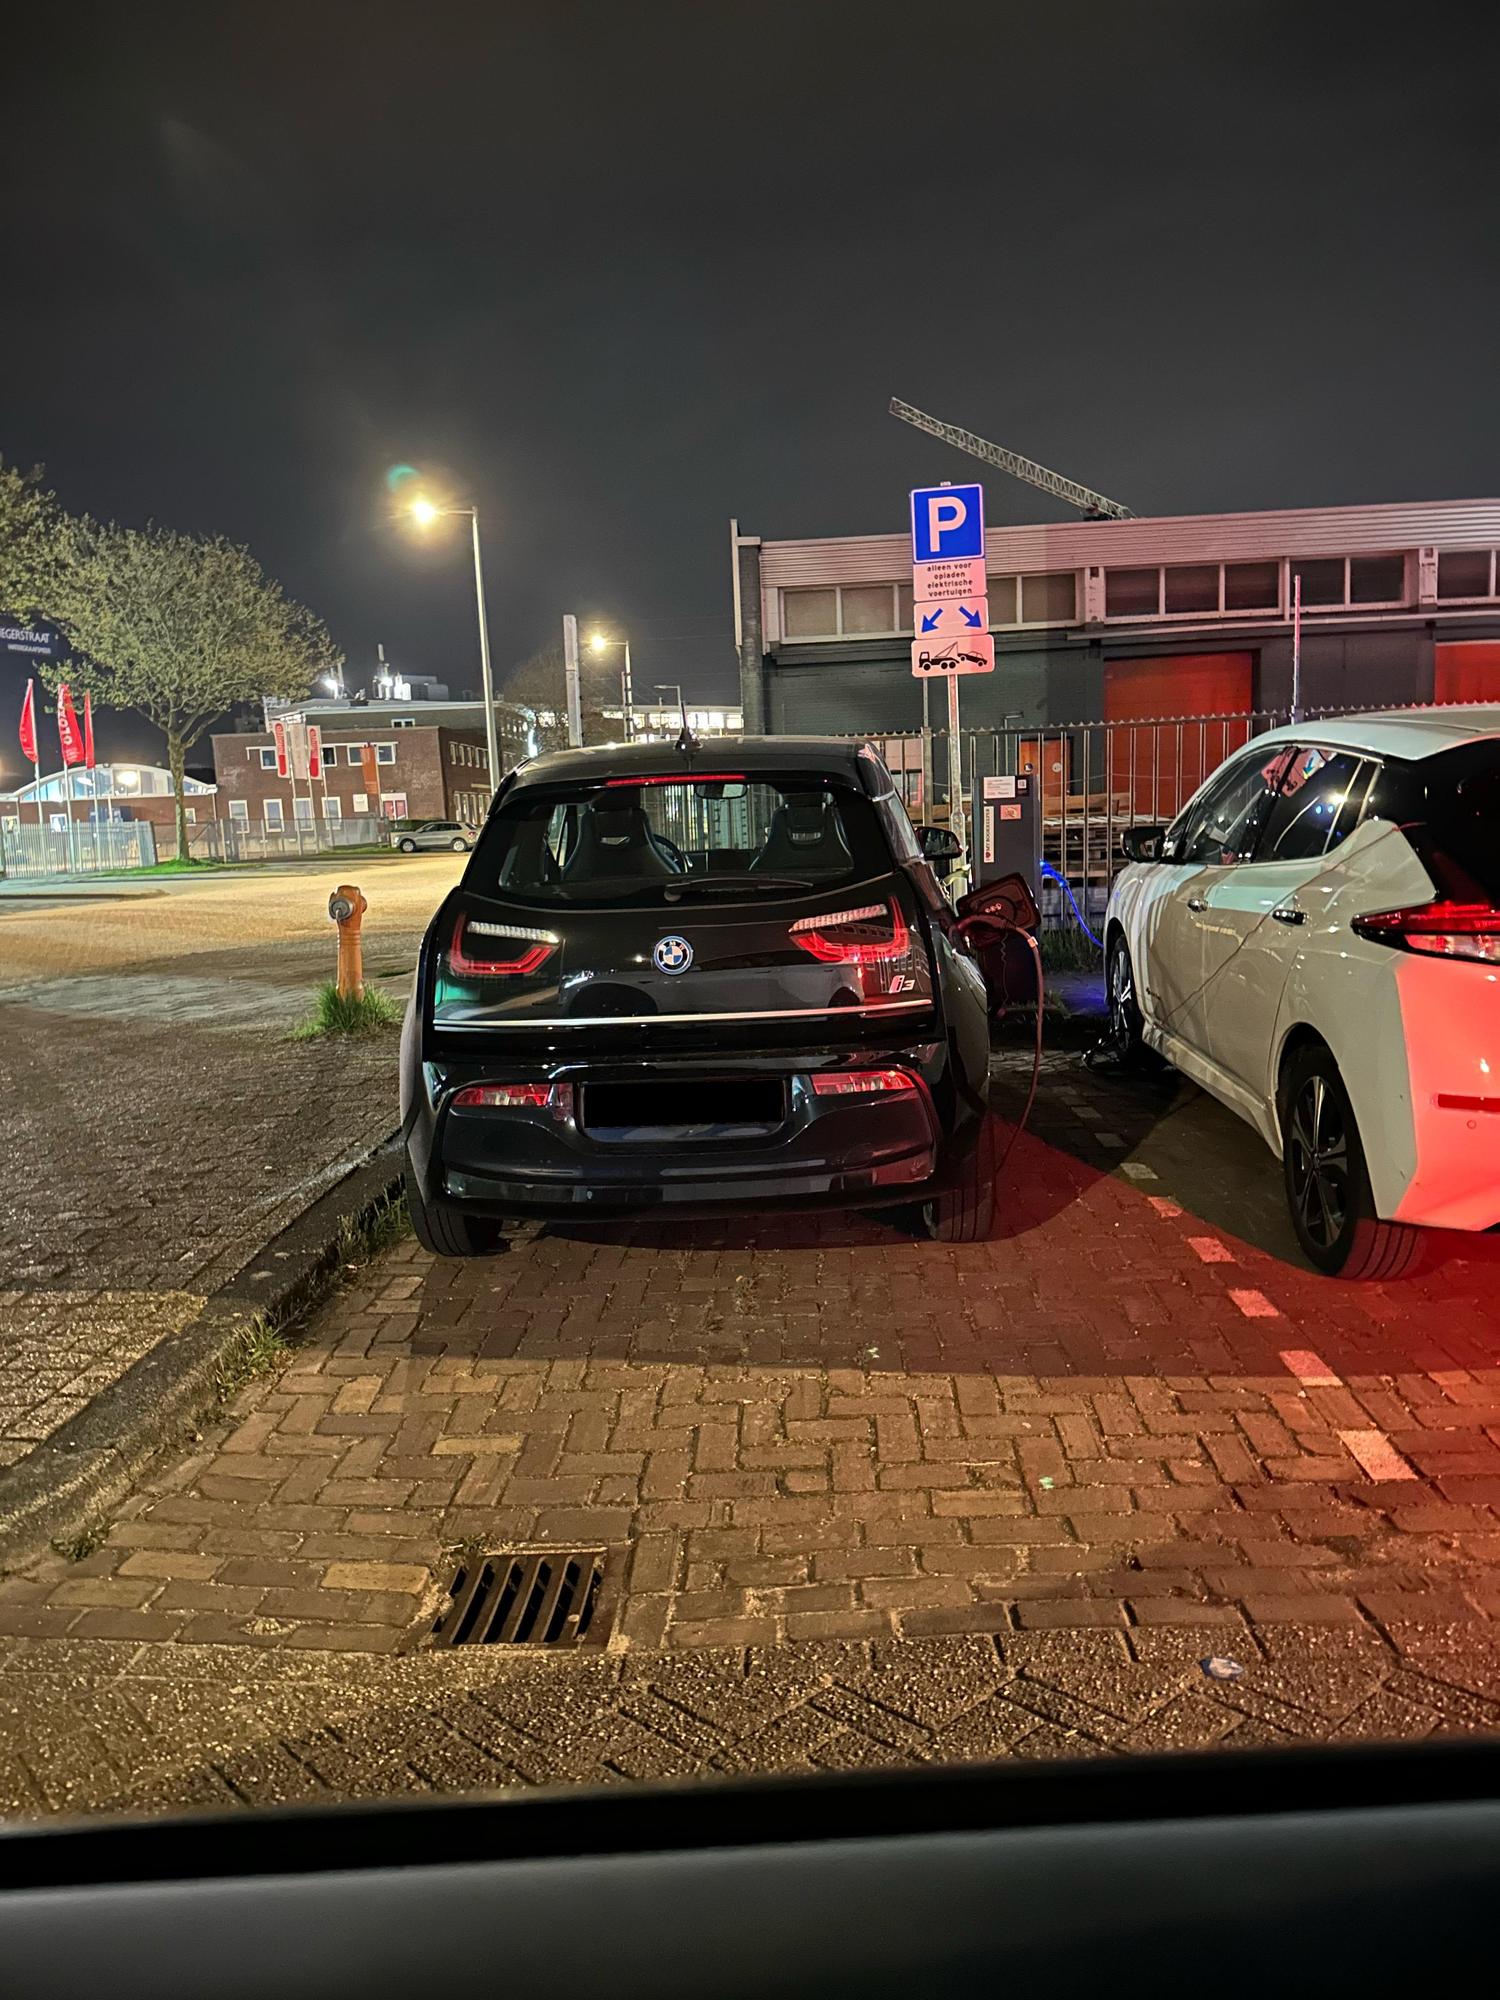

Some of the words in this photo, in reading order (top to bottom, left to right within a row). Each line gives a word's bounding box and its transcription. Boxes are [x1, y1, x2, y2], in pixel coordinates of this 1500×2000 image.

[928, 496, 967, 553] P
[927, 564, 952, 572] alleen
[934, 571, 966, 580] opladen
[927, 579, 973, 589] elektrische
[928, 587, 973, 597] voertuigen
[889, 974, 916, 994] i3
